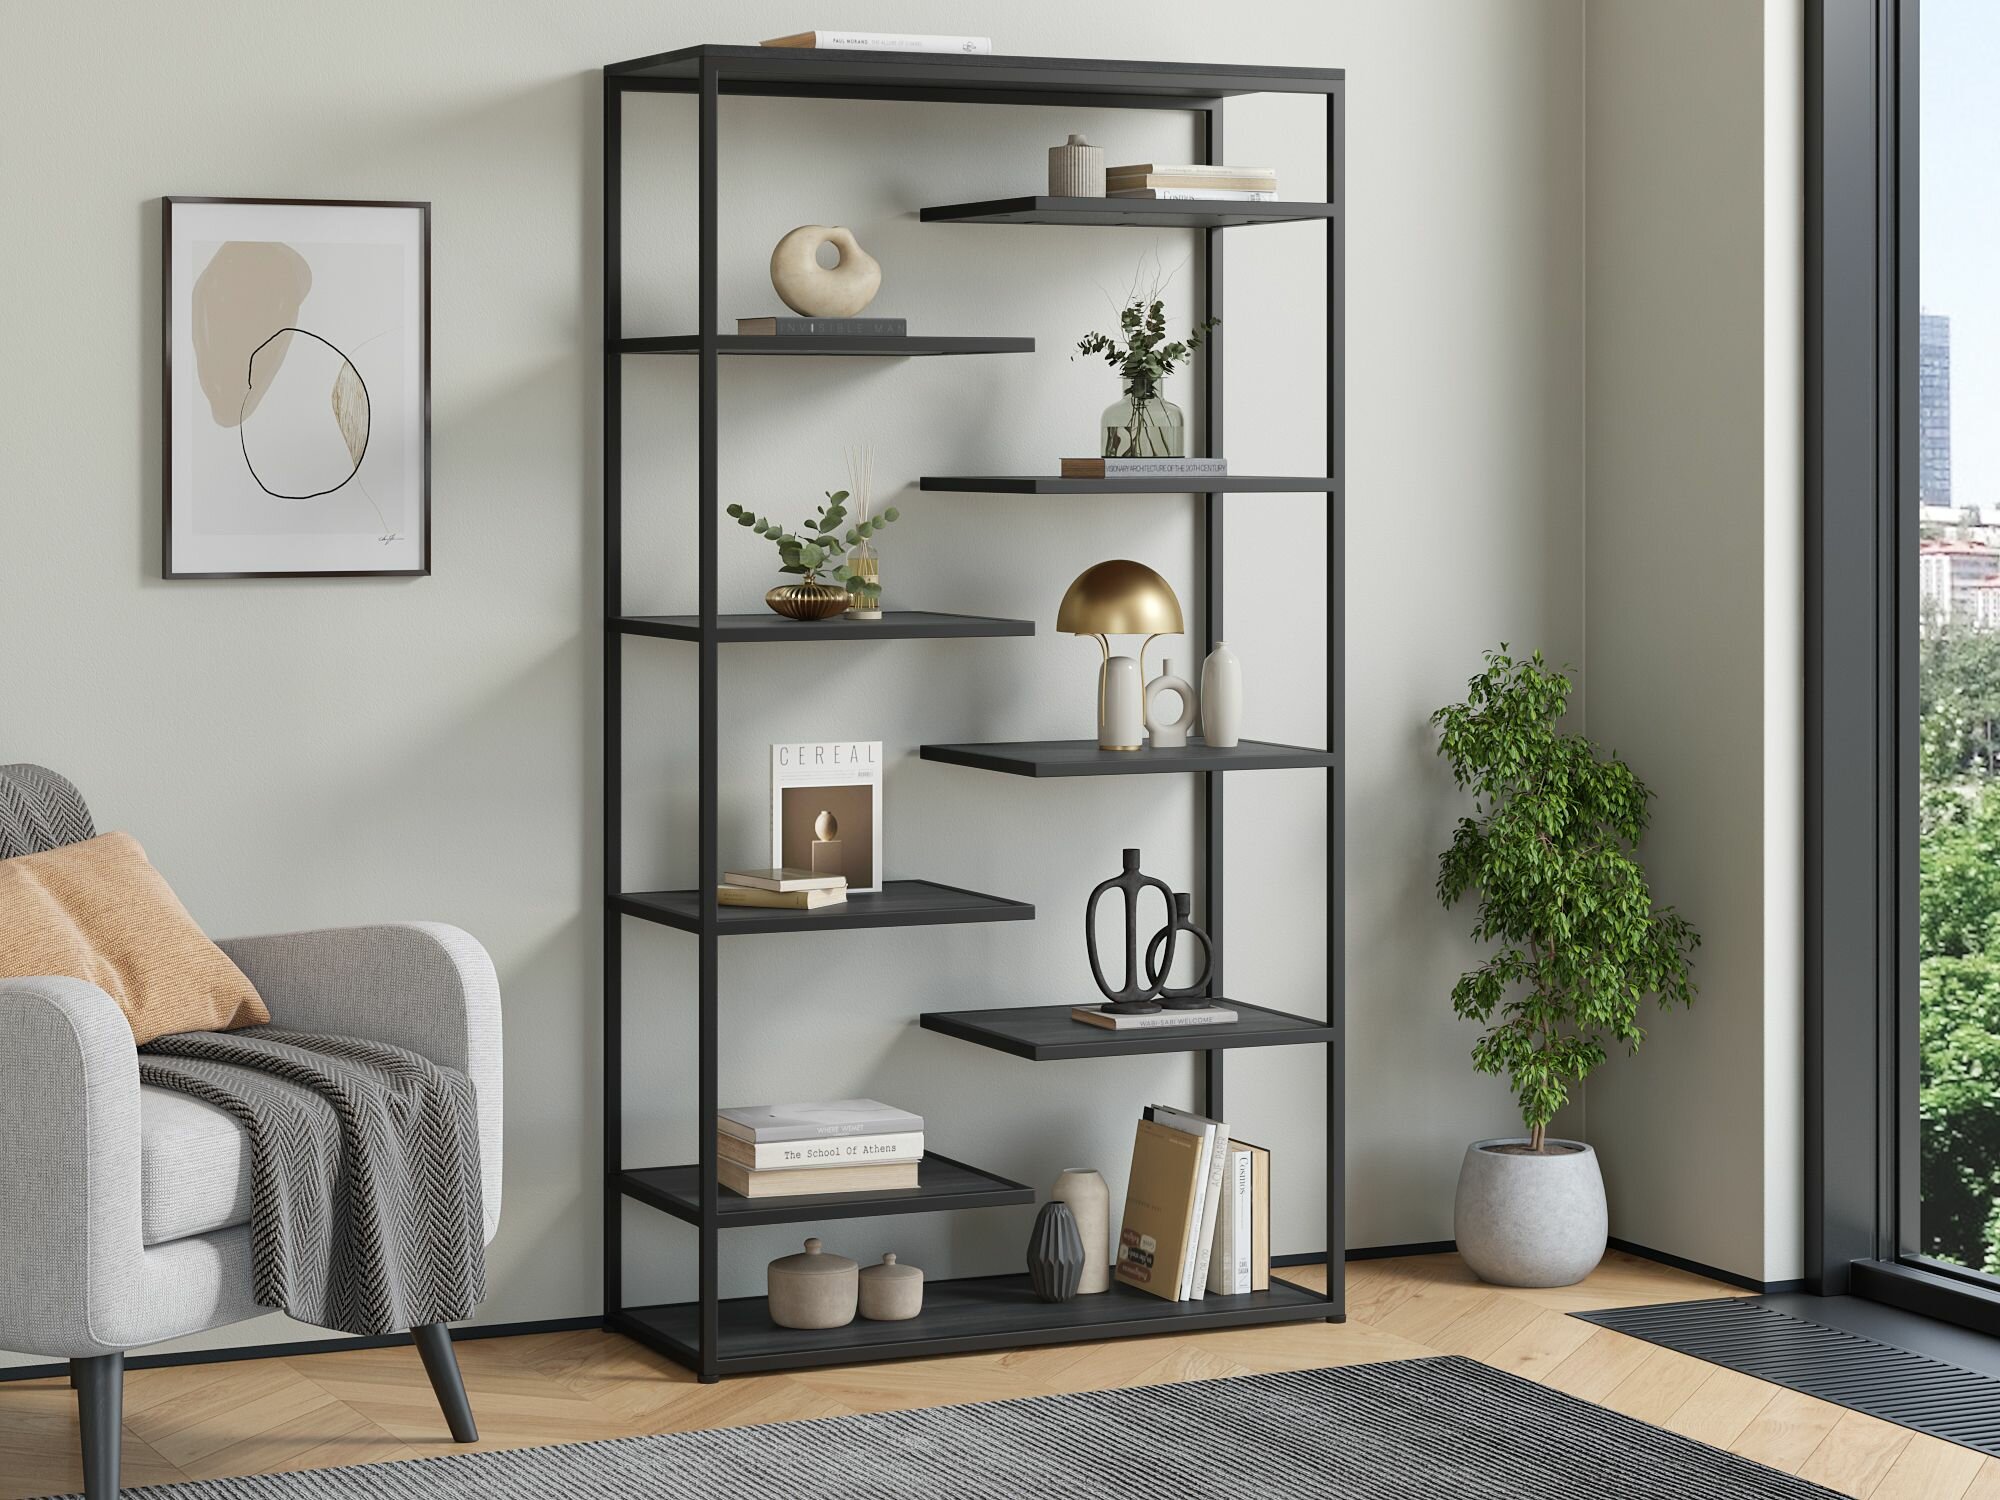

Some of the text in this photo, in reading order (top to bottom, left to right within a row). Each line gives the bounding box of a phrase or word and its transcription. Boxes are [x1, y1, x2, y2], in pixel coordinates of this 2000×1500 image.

[780, 322, 905, 333] INVISIBLE MAN
[1130, 464, 1167, 472] ARCHITECTURE
[1174, 464, 1185, 472] THE
[1186, 464, 1200, 472] 20TH
[1200, 464, 1226, 472] CENTURY
[779, 743, 876, 767] CEREAL
[1140, 1017, 1213, 1027] WABI-SABI WELCOME
[784, 1143, 897, 1160] The School Of Athens
